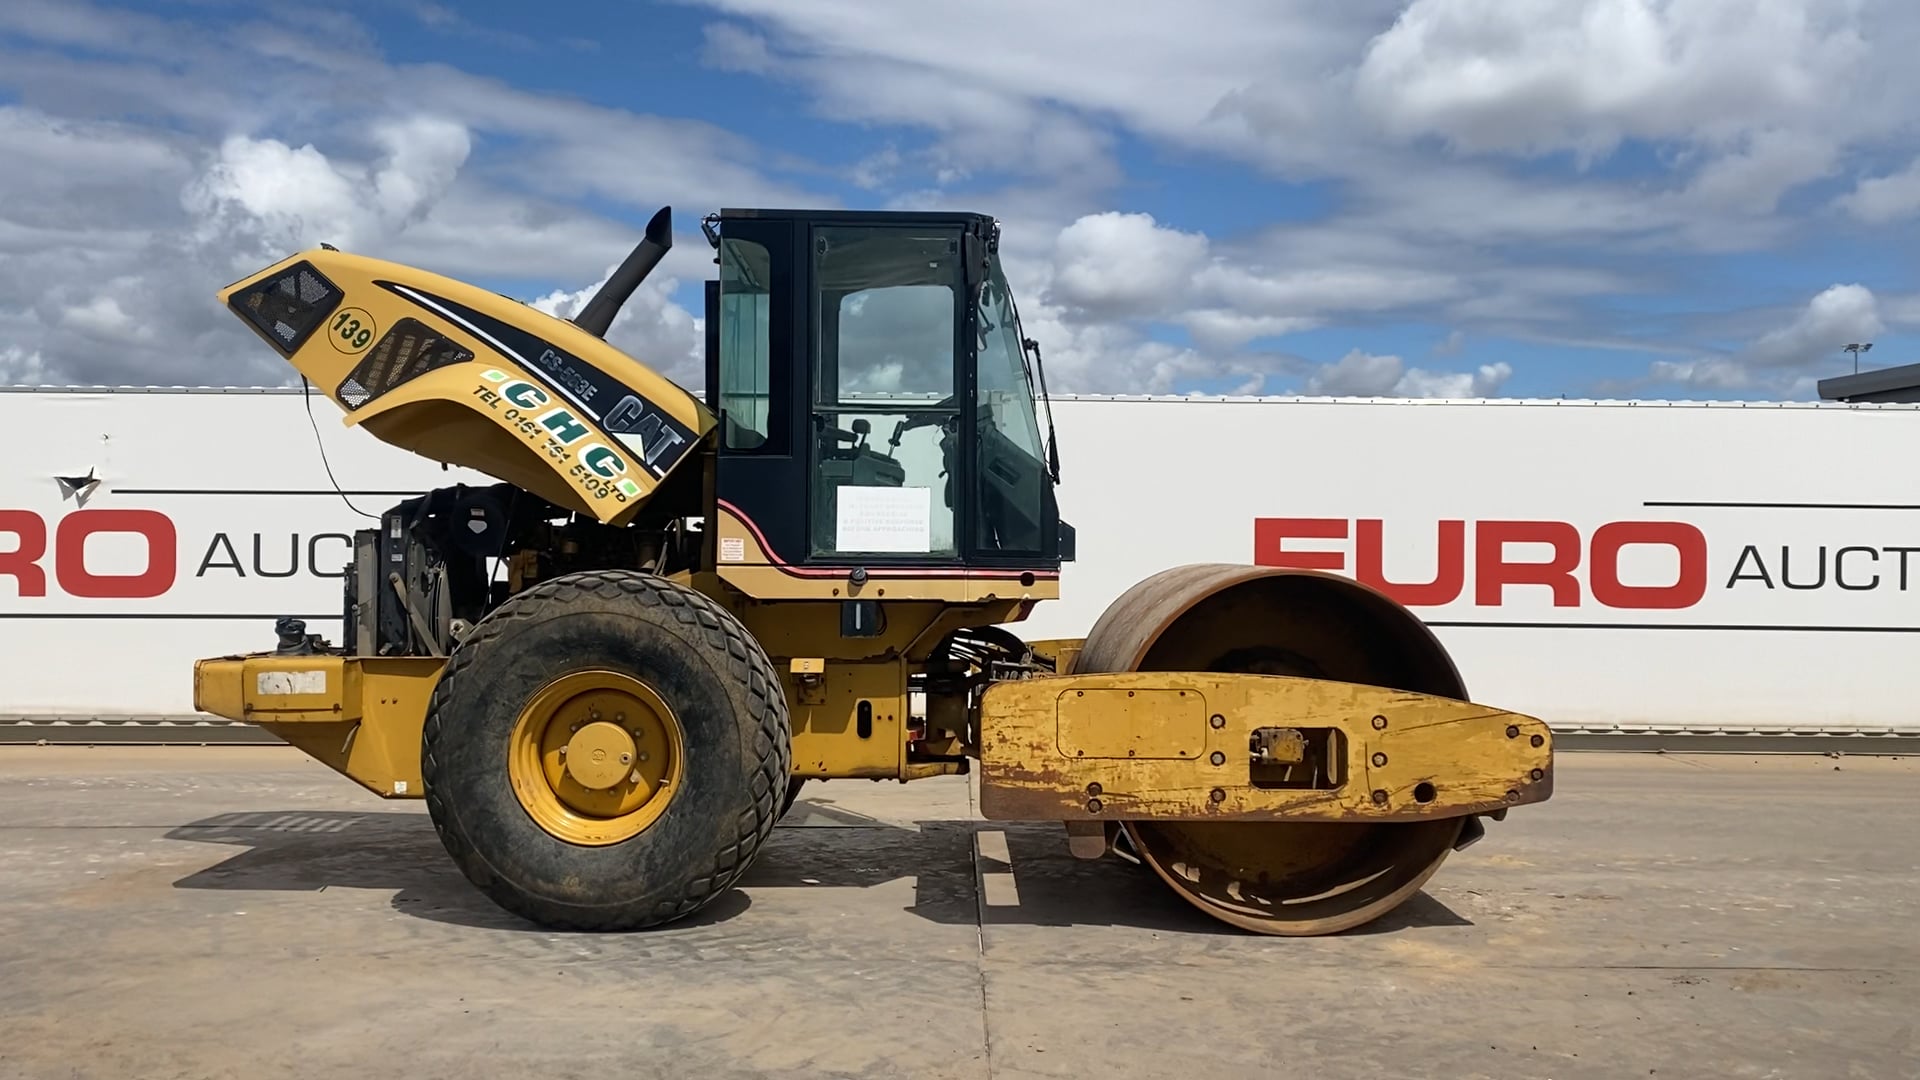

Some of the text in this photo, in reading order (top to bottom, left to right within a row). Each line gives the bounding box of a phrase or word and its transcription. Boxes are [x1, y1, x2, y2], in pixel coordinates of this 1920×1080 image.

[333, 313, 371, 348] 139
[473, 385, 609, 499] TEL 0161 761 5109
[603, 394, 683, 465] CAT
[602, 480, 627, 503] LTD
[1254, 517, 1920, 610] EURO AUCT
